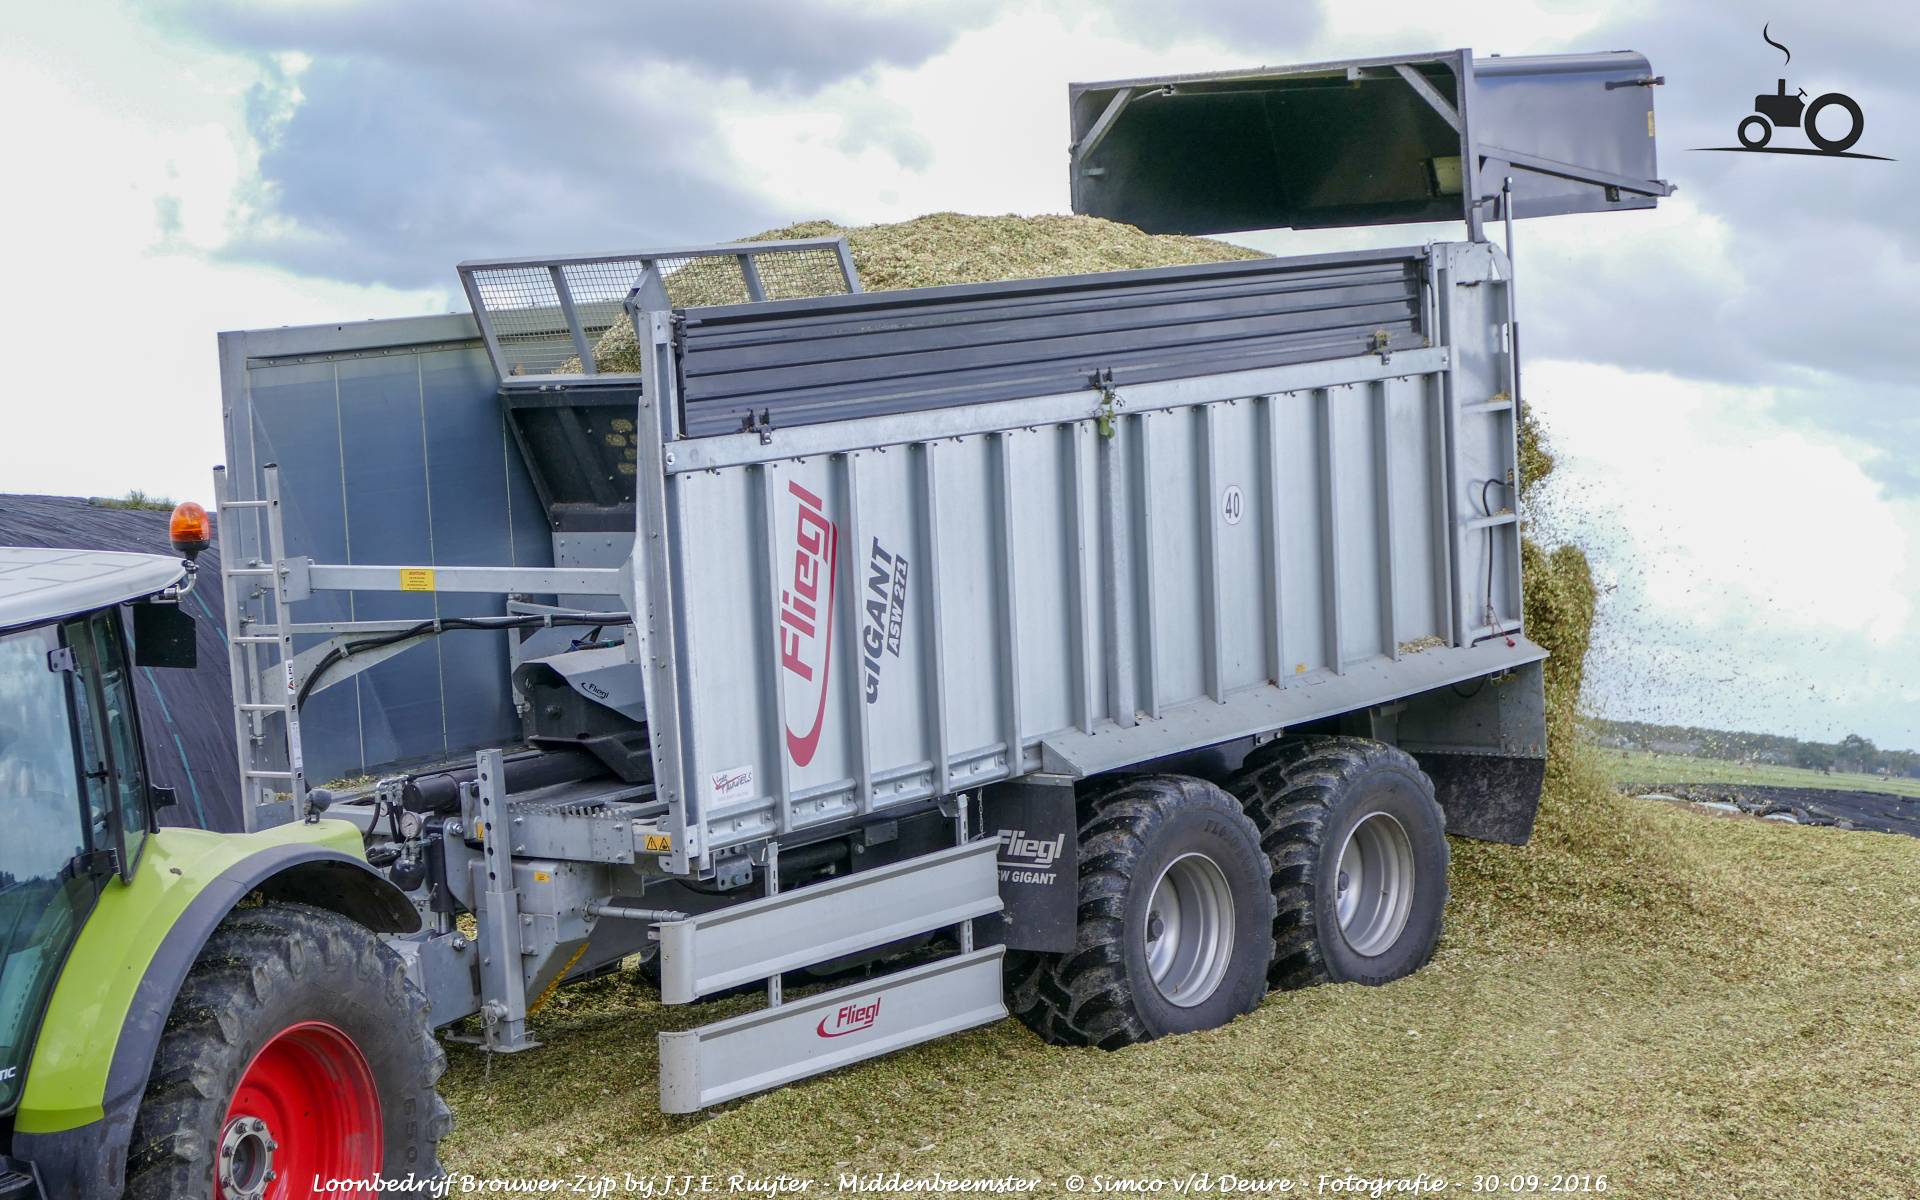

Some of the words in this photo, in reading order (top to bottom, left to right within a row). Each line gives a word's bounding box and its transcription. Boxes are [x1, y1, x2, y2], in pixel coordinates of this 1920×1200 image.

[1225, 492, 1240, 519] 40
[780, 480, 830, 682] Fliegl
[893, 560, 908, 601] 271
[863, 535, 892, 704] GIGANT
[887, 602, 903, 656] ASW
[996, 829, 1065, 864] Fliegl
[1012, 870, 1057, 885] GIGANT
[836, 996, 881, 1029] Fliegl
